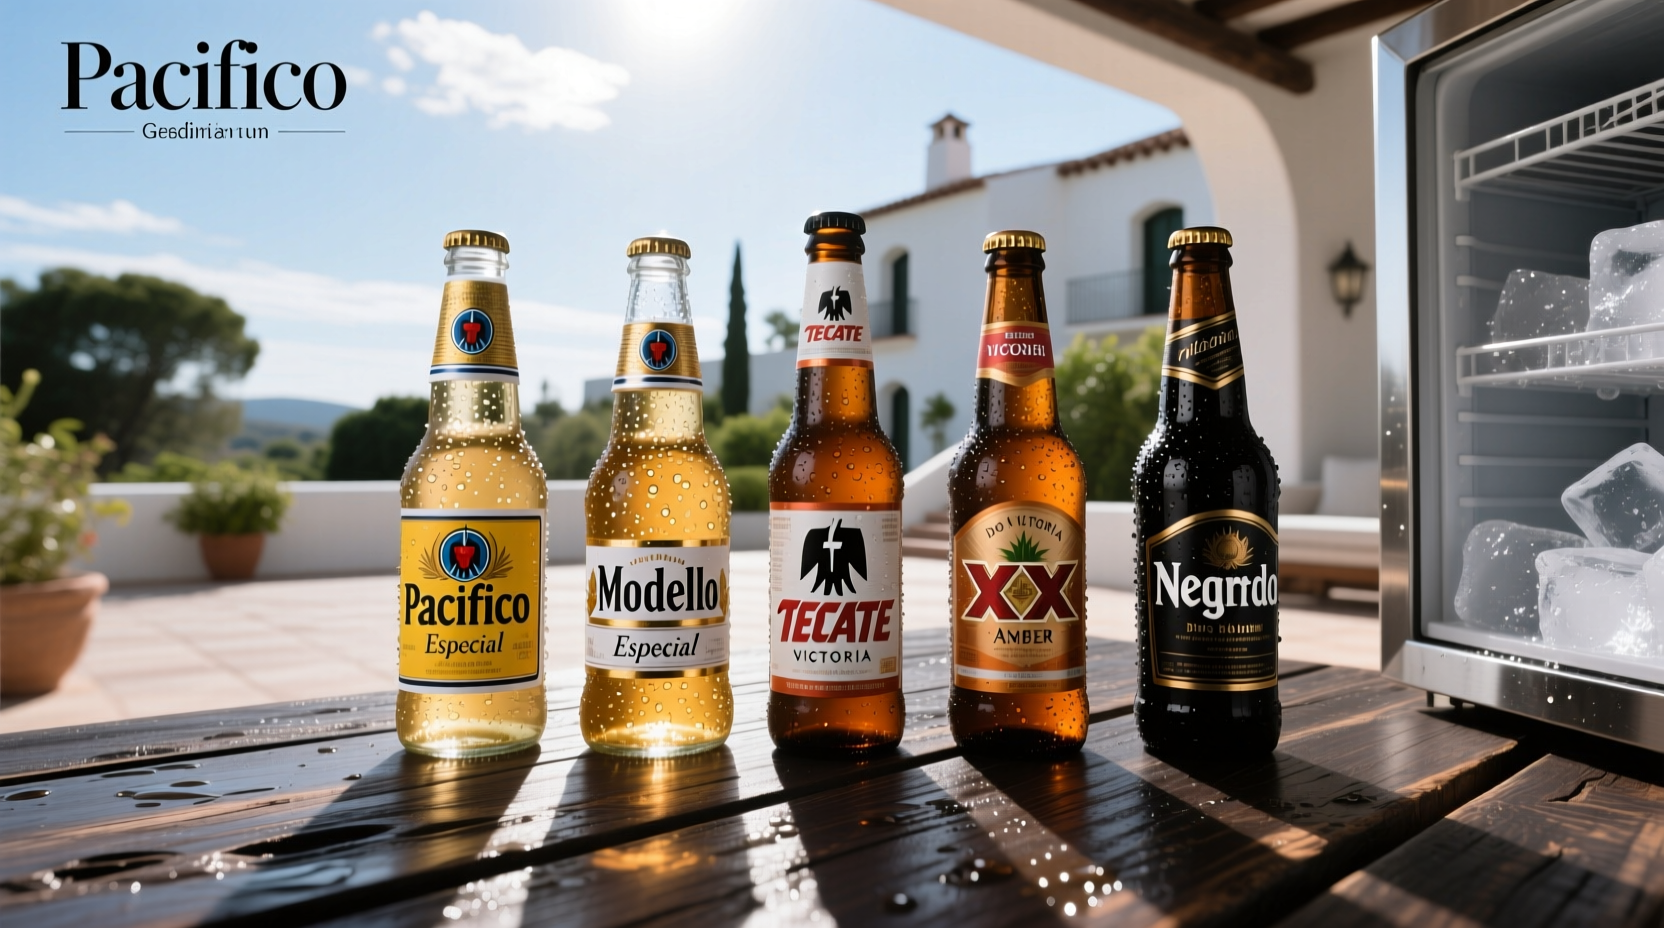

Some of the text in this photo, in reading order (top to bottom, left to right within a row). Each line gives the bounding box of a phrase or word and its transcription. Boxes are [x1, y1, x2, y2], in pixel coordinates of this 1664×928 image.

[804, 324, 864, 343] TECATE
[404, 582, 531, 627] Pacifico
[598, 564, 719, 613] Modello
[962, 559, 1079, 623] XX
[777, 598, 896, 643] TECATE
[993, 628, 1054, 645] AMBER
[424, 631, 505, 660] Especial
[612, 632, 700, 664] Especial
[793, 648, 872, 664] VICTORIA
